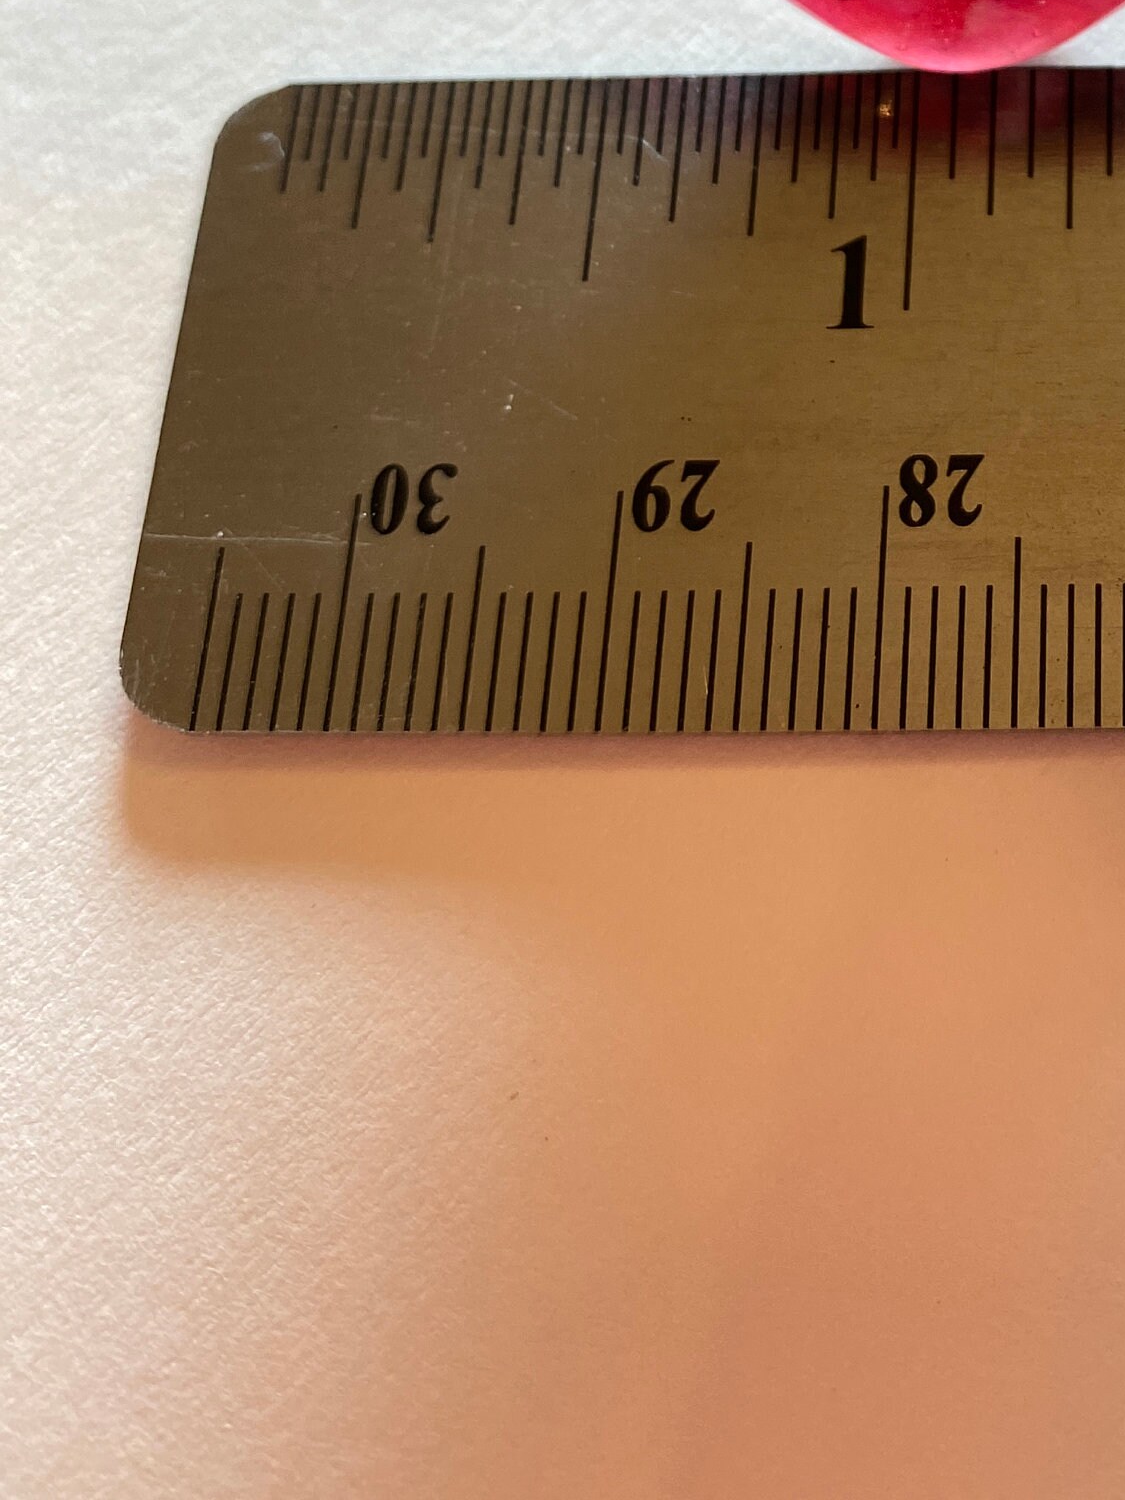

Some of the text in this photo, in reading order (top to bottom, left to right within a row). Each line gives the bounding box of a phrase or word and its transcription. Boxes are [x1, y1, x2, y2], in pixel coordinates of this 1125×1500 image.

[826, 234, 875, 330] 1
[370, 462, 458, 536] 30
[631, 459, 720, 533] 29
[898, 453, 986, 528] 28
